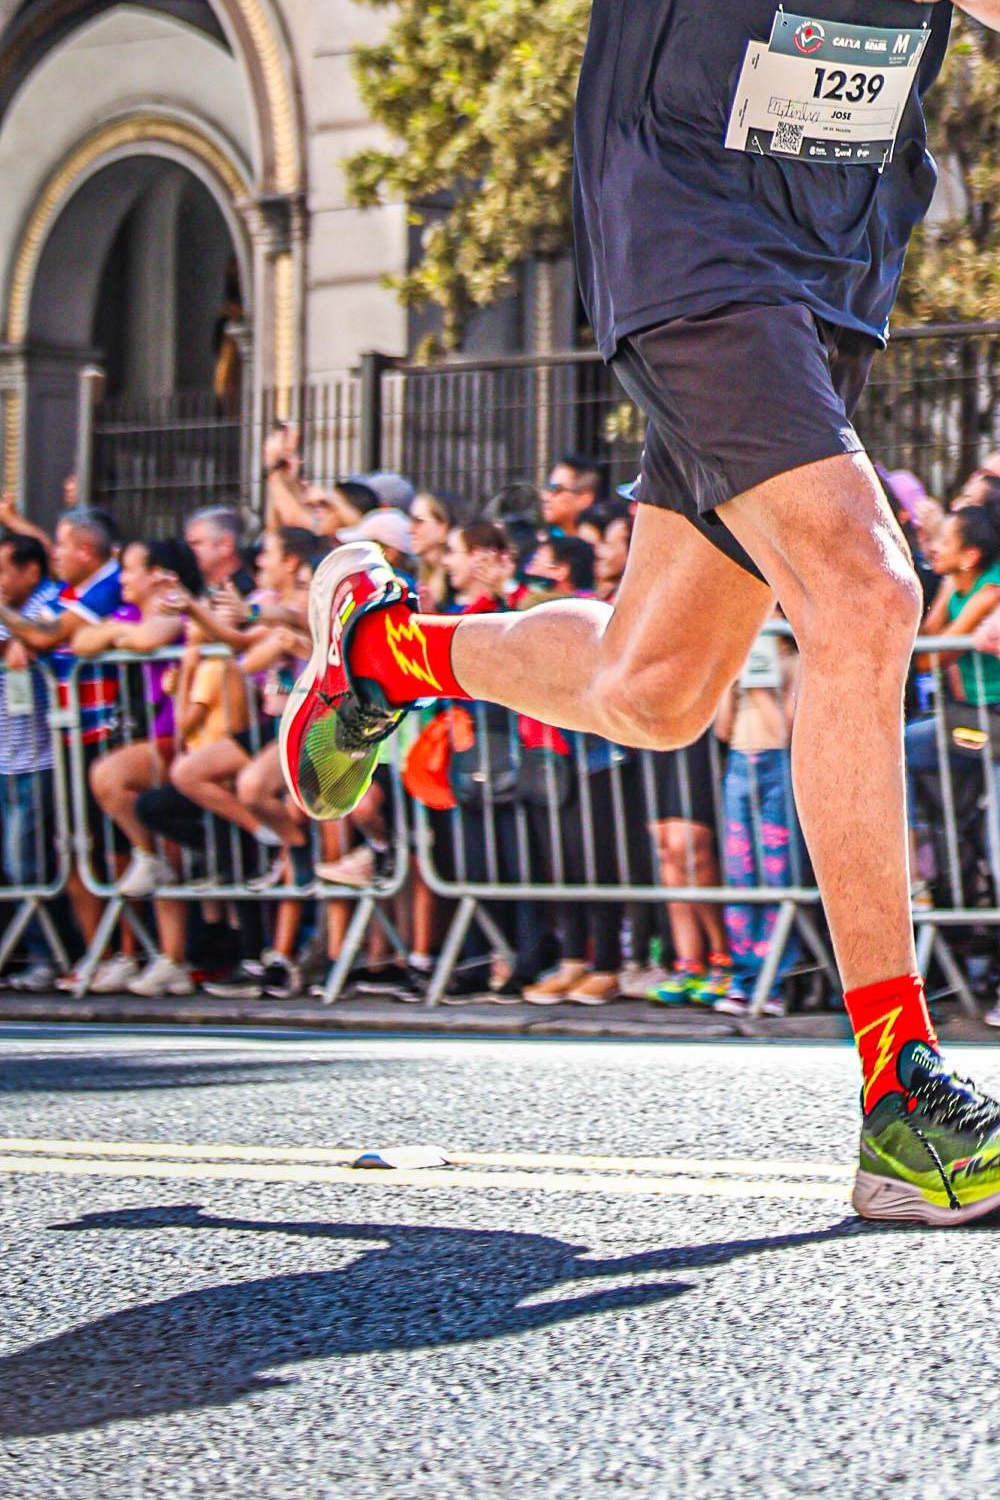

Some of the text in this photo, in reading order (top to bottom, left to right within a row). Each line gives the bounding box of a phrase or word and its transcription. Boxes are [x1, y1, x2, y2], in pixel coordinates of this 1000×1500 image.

[832, 37, 861, 49] CAIXA
[893, 34, 910, 54] M
[813, 67, 885, 104] 1239
[830, 110, 852, 121] JOSE
